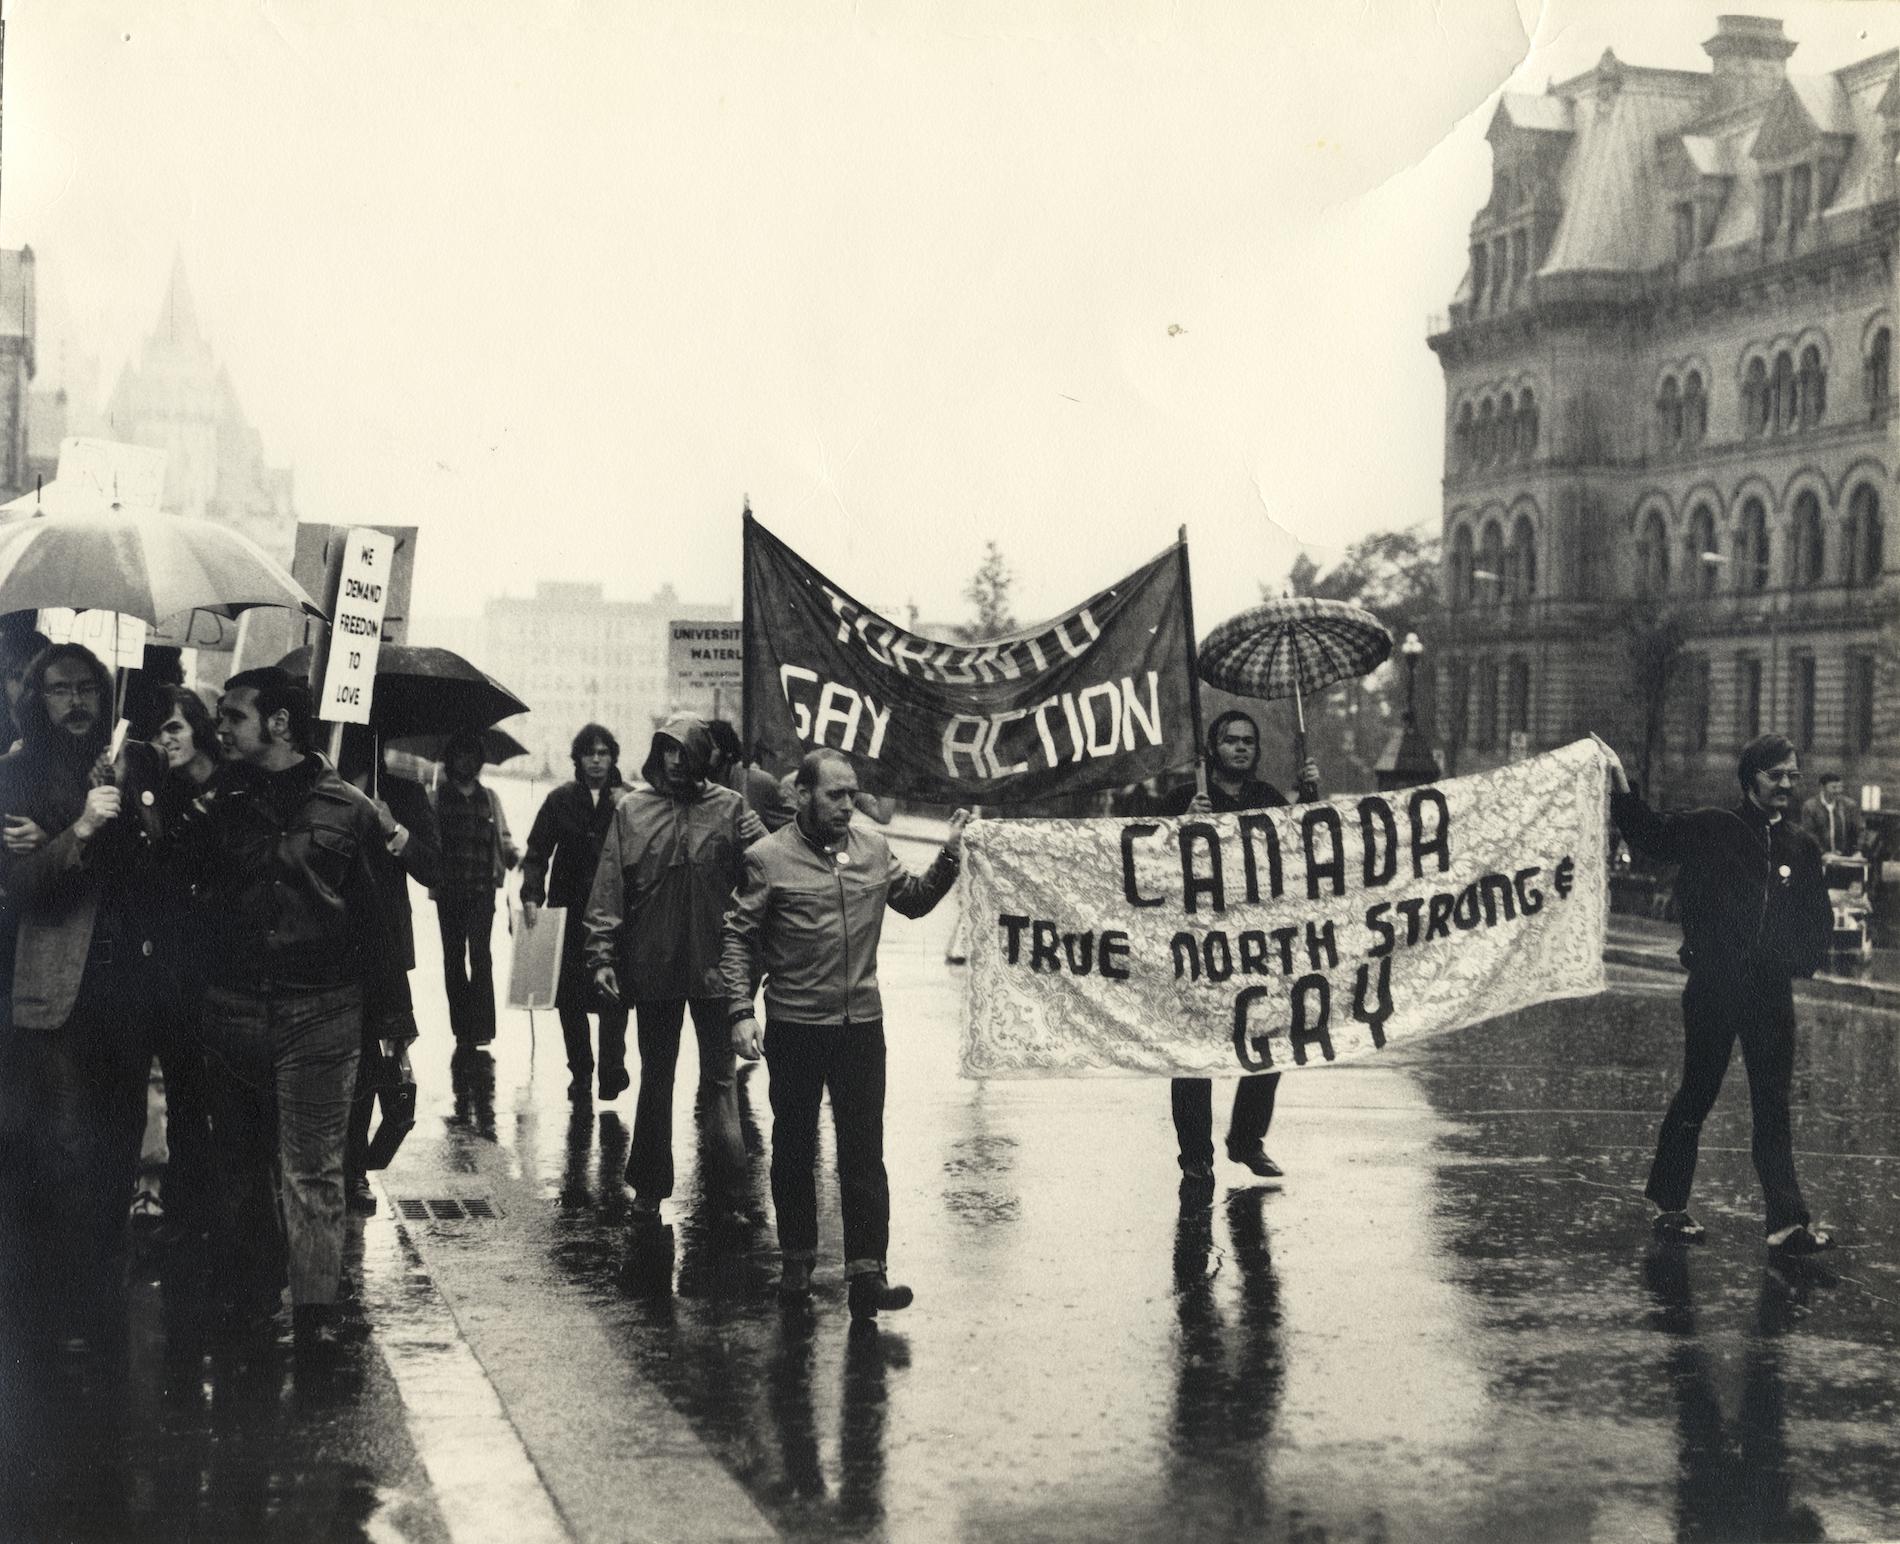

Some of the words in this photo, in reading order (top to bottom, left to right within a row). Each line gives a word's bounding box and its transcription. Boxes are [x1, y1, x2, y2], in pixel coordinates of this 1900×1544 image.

[361, 546, 375, 566] WE
[345, 579, 382, 603] DEMAND
[340, 613, 378, 638] FREEDOM
[673, 629, 741, 640] UNIVERSIT
[349, 652, 361, 669] TO
[691, 648, 743, 660] WATERL
[336, 685, 361, 705] LOVE
[780, 663, 891, 759] GAY
[942, 671, 1163, 779] ACTION
[1121, 788, 1450, 914] CANADA
[999, 914, 1131, 980] TRUE
[1170, 919, 1340, 982] NORTH
[1365, 866, 1544, 958] STRONG
[1233, 956, 1395, 1072] GAY
